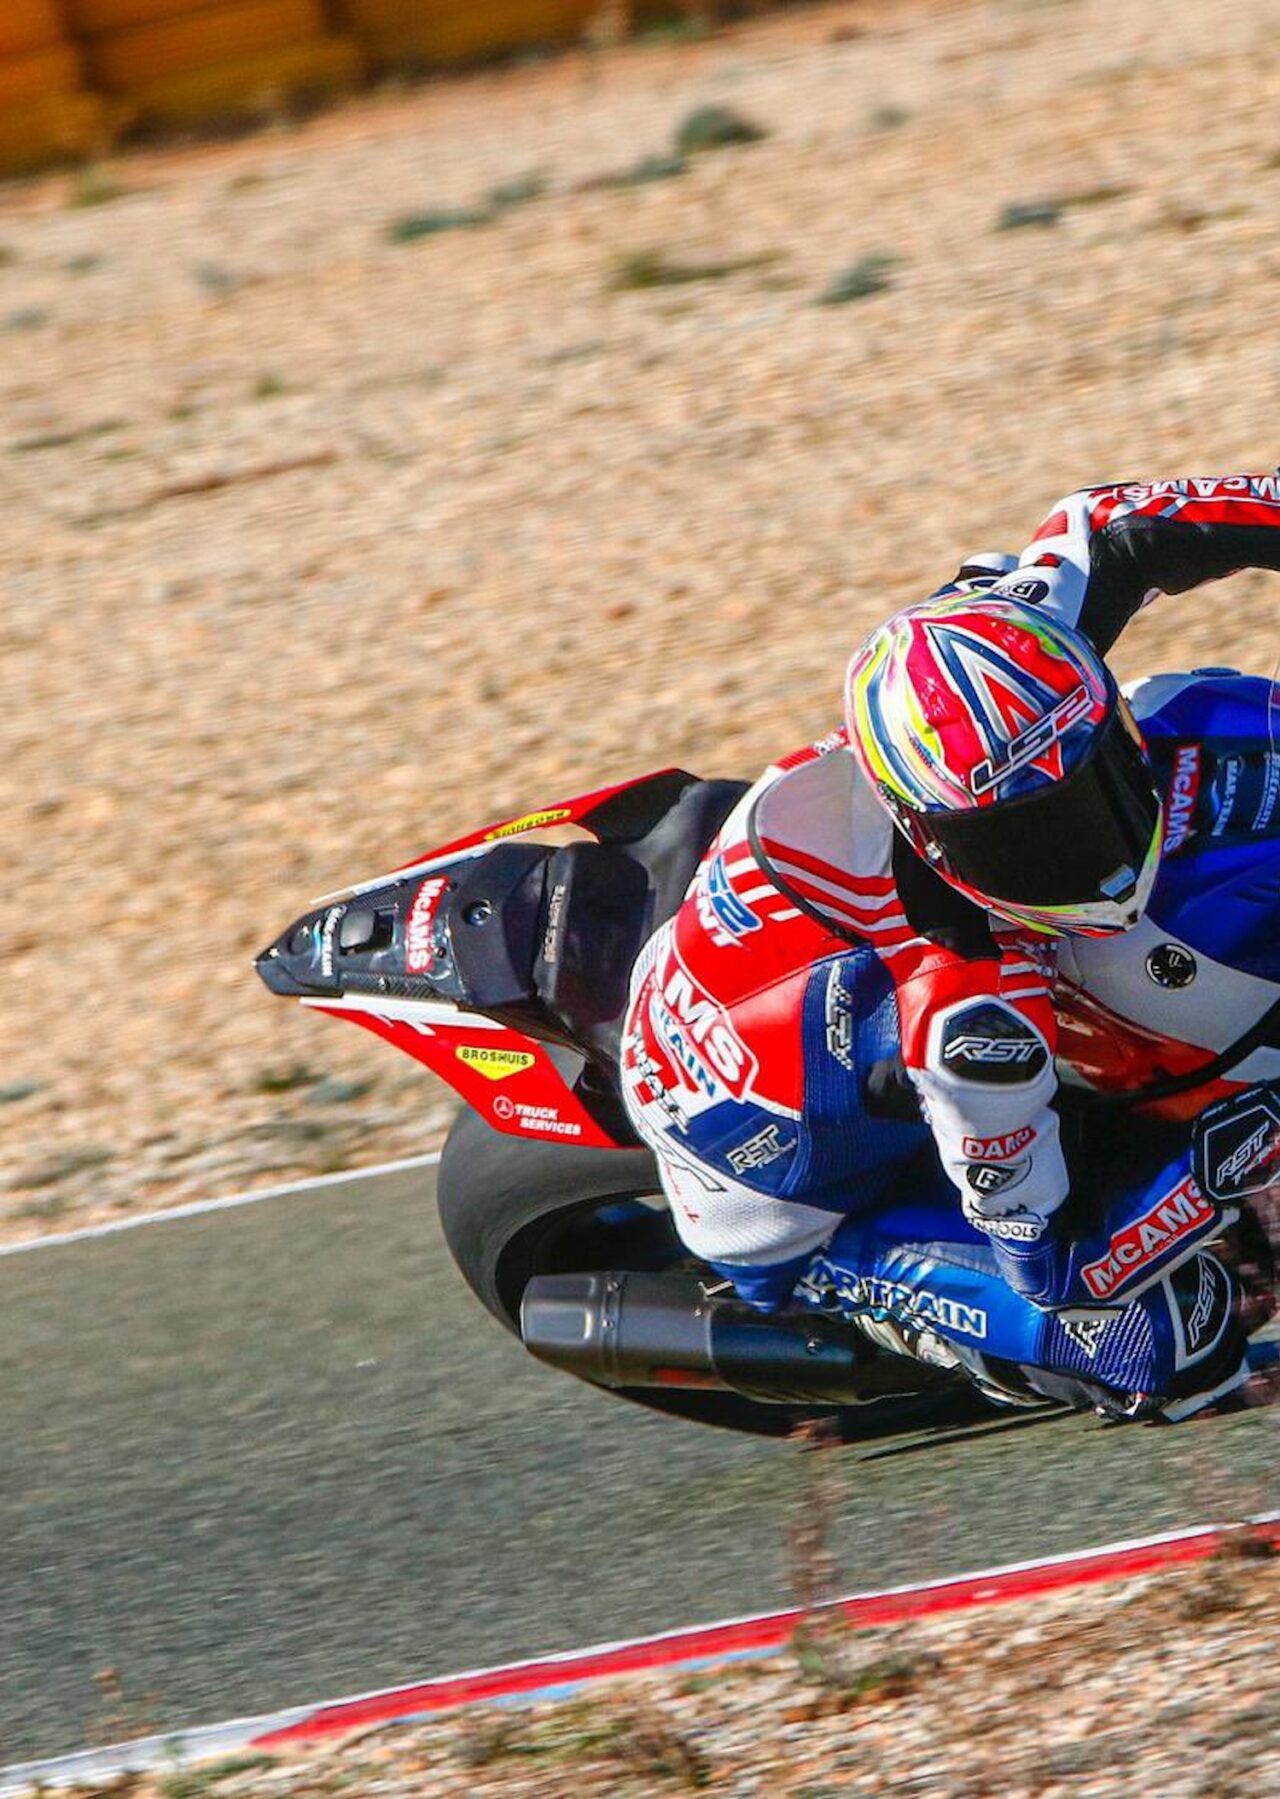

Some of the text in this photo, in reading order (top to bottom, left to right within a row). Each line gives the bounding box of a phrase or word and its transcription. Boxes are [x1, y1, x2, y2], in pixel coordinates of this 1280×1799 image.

[1163, 747, 1198, 853] McAMS
[406, 877, 445, 970] McAMS
[462, 1048, 529, 1066] BROSHUIS
[944, 1035, 1042, 1062] RST
[514, 1103, 558, 1121] TRUCK
[520, 1117, 582, 1136] SERVICES
[726, 1124, 780, 1175] RST
[1216, 1121, 1270, 1187] RST
[796, 1258, 987, 1339] AR-TRAIN
[1186, 1259, 1218, 1348] RST
